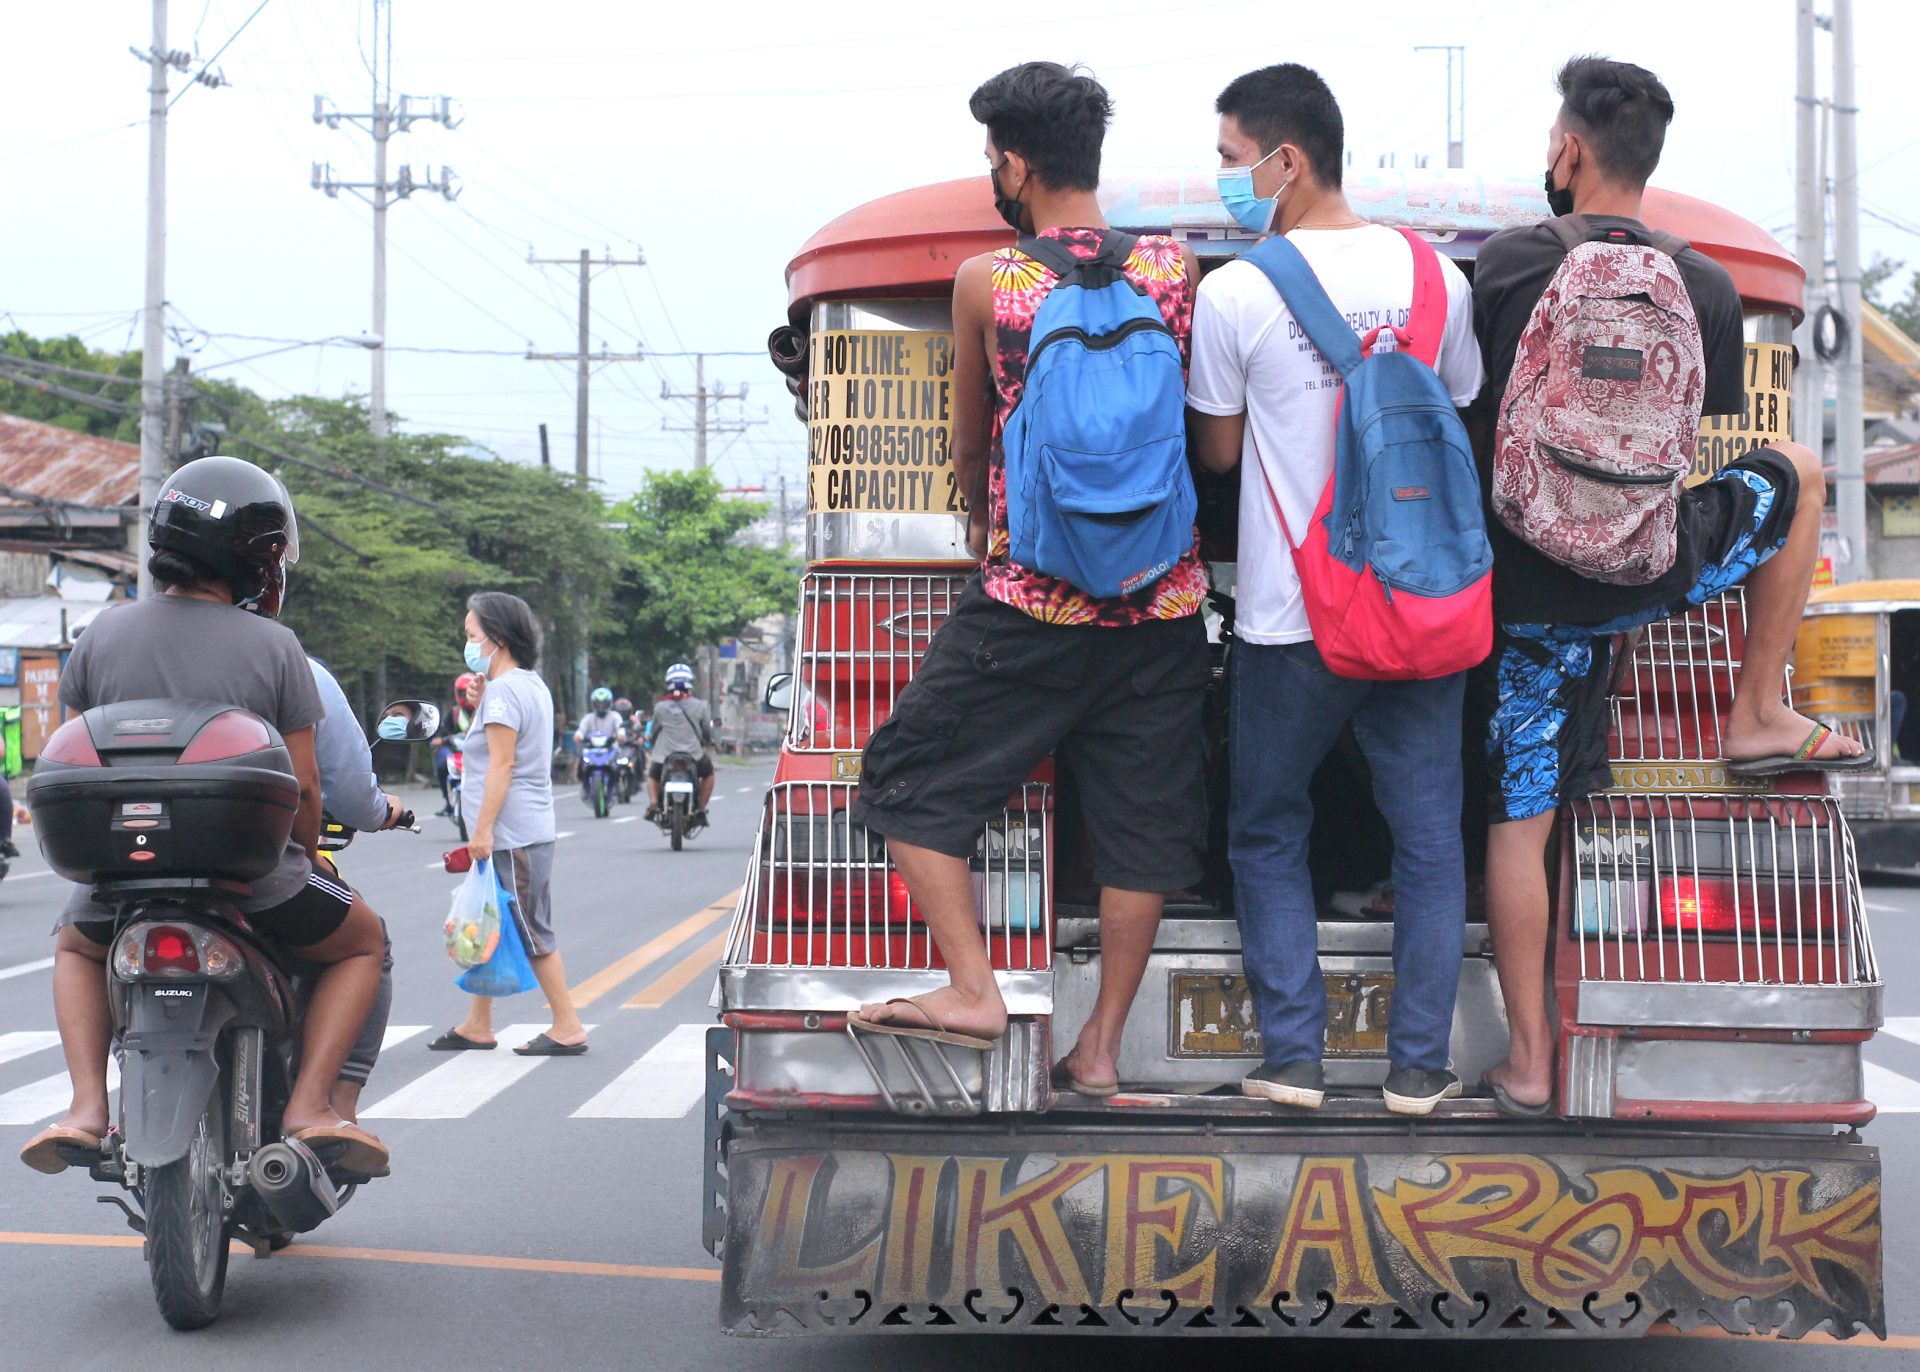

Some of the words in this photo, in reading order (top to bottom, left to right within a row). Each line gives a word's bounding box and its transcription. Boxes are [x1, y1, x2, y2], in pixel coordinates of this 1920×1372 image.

[1386, 310, 1393, 326] &
[824, 335, 910, 376] HOTLINE:
[846, 379, 949, 420] HOTLINE
[1304, 380, 1318, 391] TEL.
[828, 469, 934, 511] CAPACITY
[154, 989, 193, 997] SUZUKI
[757, 1153, 1224, 1308] LIKE
[1256, 1157, 1398, 1306] A
[1372, 1153, 1880, 1310] ROCK
